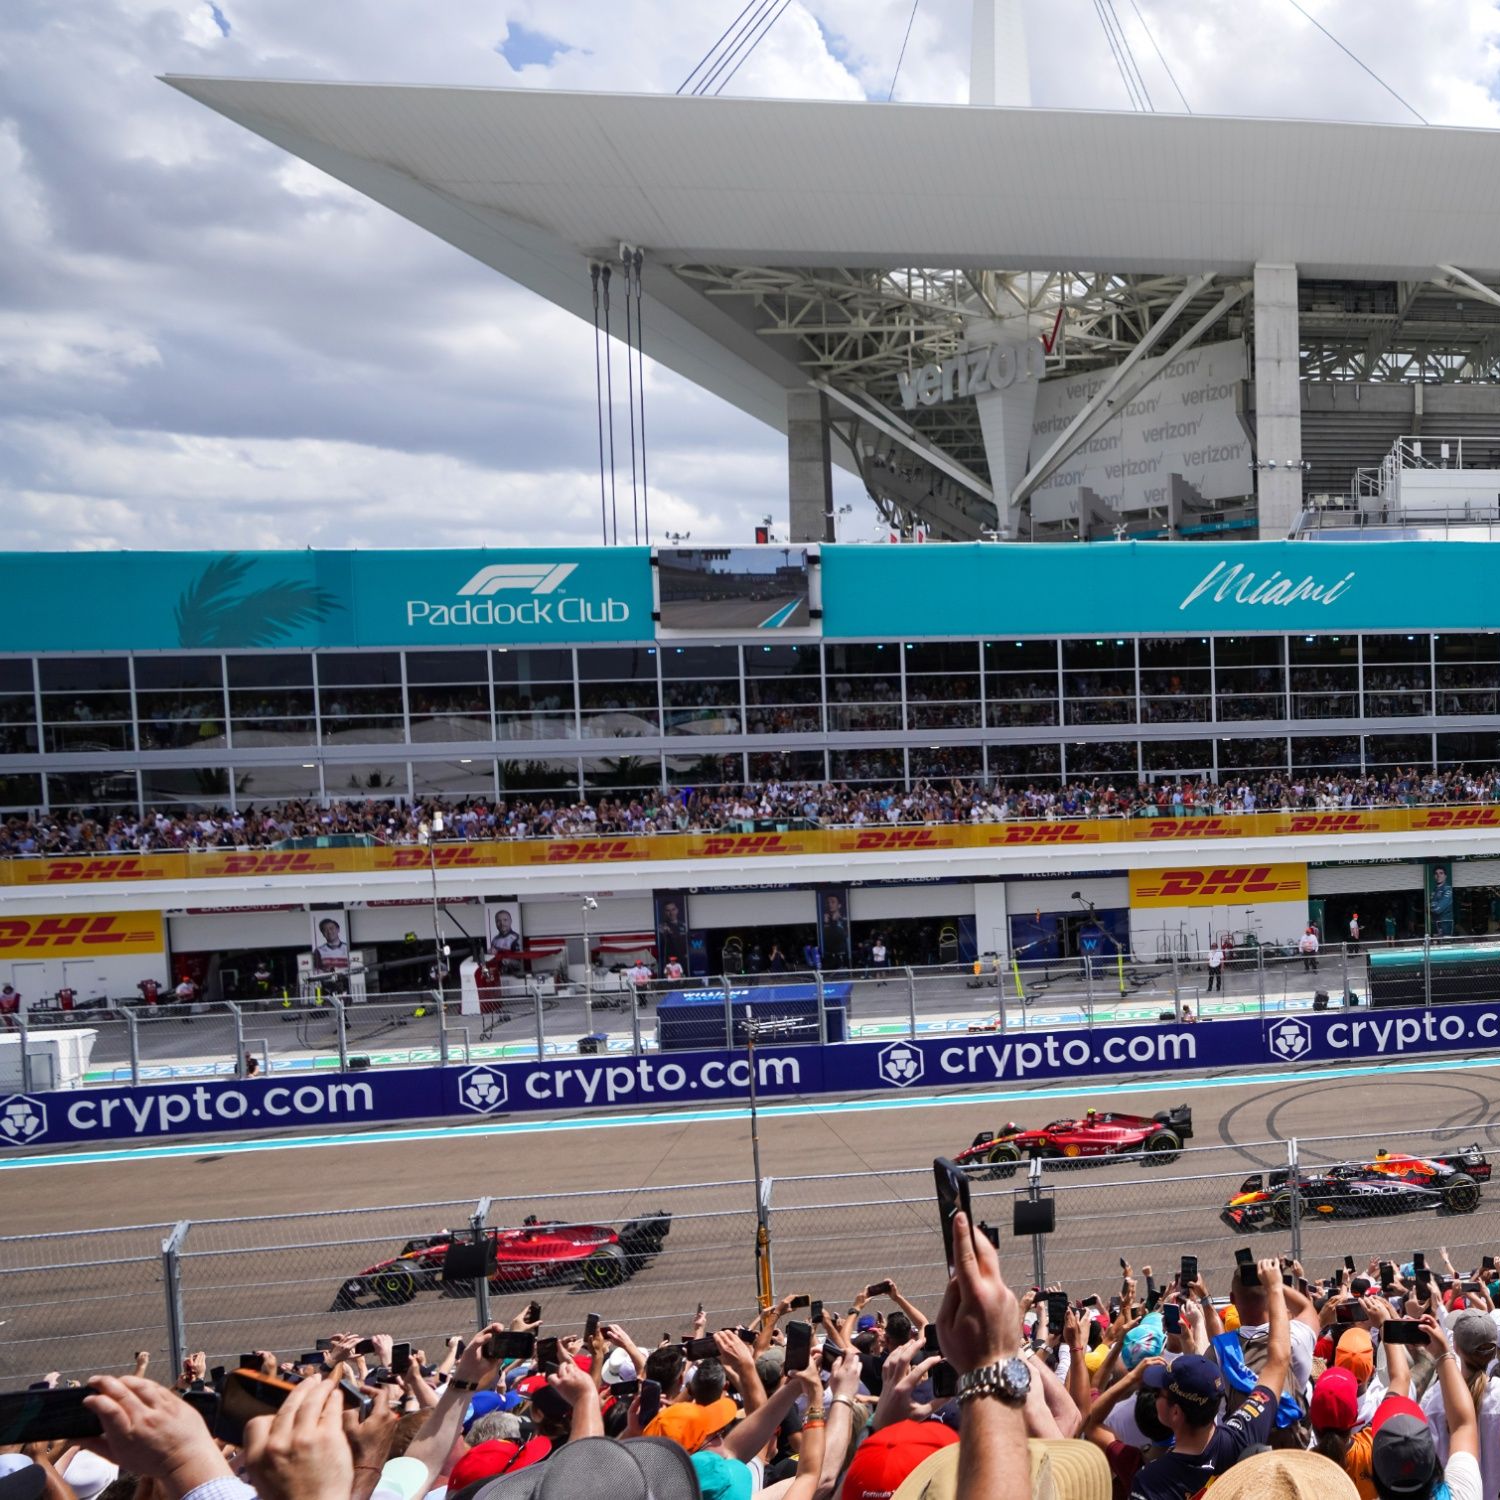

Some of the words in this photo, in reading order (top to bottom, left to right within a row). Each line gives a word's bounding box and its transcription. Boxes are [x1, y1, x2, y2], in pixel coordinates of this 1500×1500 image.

[897, 336, 1046, 409] verizon
[1155, 358, 1197, 382] rizon
[1066, 375, 1107, 400] veriz
[1115, 395, 1157, 420] rizon
[1032, 412, 1077, 436] verizo
[1142, 418, 1198, 444] verizon
[1075, 434, 1118, 457] erizon
[1182, 442, 1241, 468] verizon
[1104, 456, 1158, 481] verizon
[1036, 470, 1082, 492] erizon
[456, 563, 579, 595] F1
[1180, 560, 1355, 610] Miami
[407, 598, 553, 626] Paddock
[557, 597, 630, 623] Club
[1150, 820, 1229, 837] DHL
[1289, 815, 1365, 832] DHL
[1426, 809, 1500, 827] DHL
[703, 836, 789, 855] DHL
[856, 830, 940, 849] DHL
[1004, 825, 1089, 843] DHL
[224, 854, 317, 873] DHL
[392, 847, 480, 867] DHL
[548, 842, 635, 861] DHL
[47, 860, 145, 881] DHL
[1159, 867, 1282, 896] DHL
[0, 916, 127, 947] DHL
[940, 1032, 1198, 1079] crypto.com
[525, 1057, 801, 1103] crypto.com
[66, 1082, 374, 1133] crypto.com
